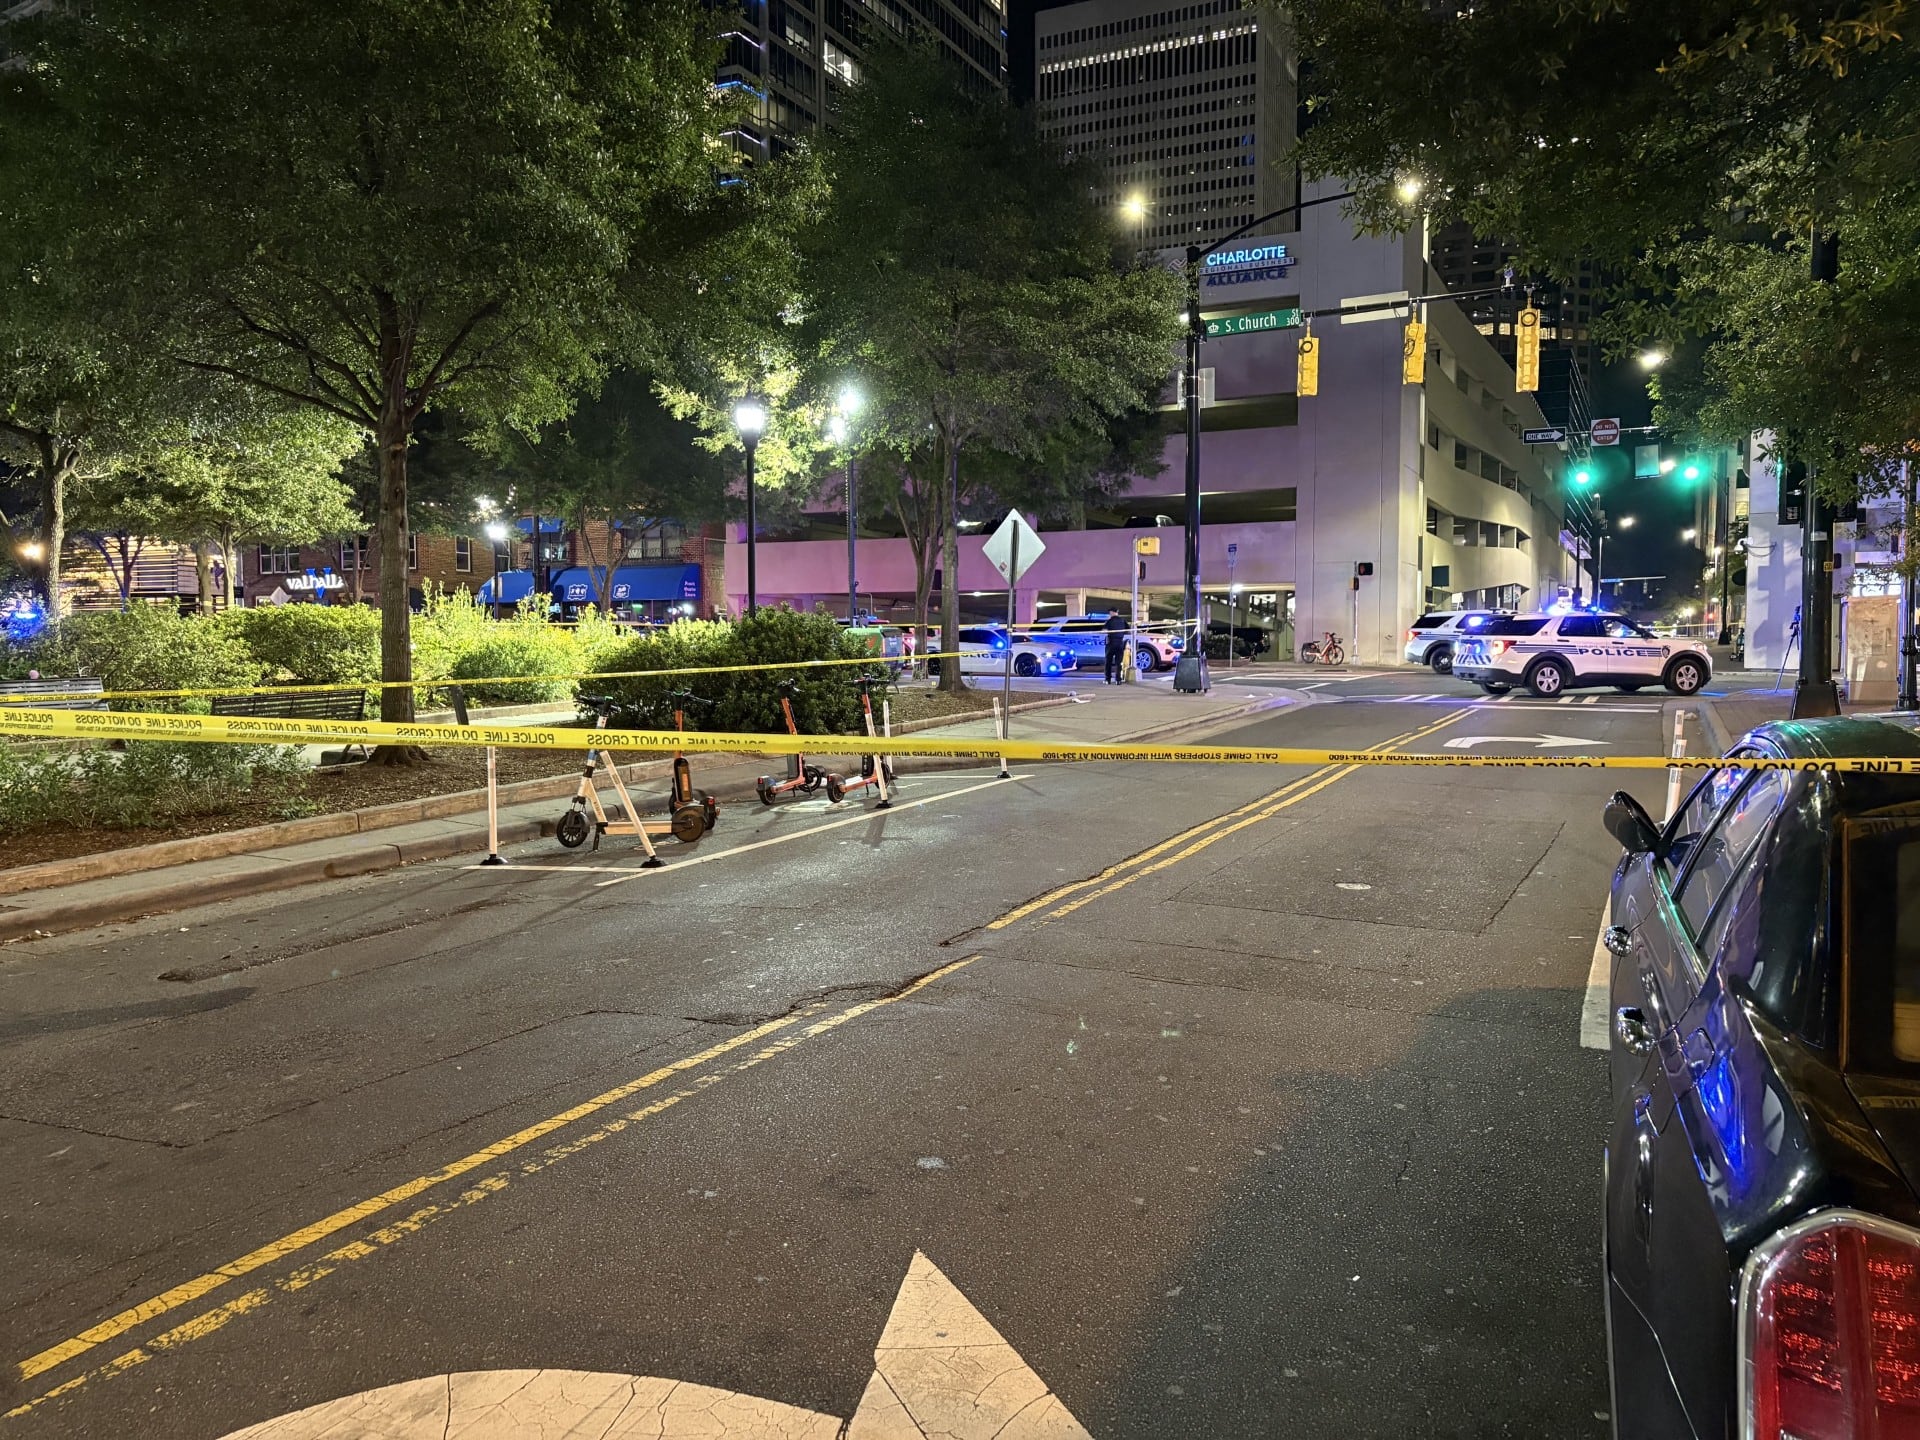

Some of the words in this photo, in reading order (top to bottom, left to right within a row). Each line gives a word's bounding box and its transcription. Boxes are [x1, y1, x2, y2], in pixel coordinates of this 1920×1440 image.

[1206, 245, 1286, 266] CHARLOTTE
[1249, 257, 1293, 268] BUSINESS
[1206, 267, 1288, 287] ALLIANCE
[1225, 319, 1235, 332] S.
[1238, 313, 1277, 330] Church
[1291, 308, 1299, 317] St
[1286, 316, 1300, 326] 300
[1578, 648, 1648, 657] POLICE
[1079, 752, 1089, 760] AT
[1090, 752, 1149, 760] INFORMATION
[1150, 752, 1172, 760] WITH
[1174, 752, 1222, 760] STOPPERS
[1223, 752, 1252, 760] CRIME
[1851, 761, 1903, 772] LINE
